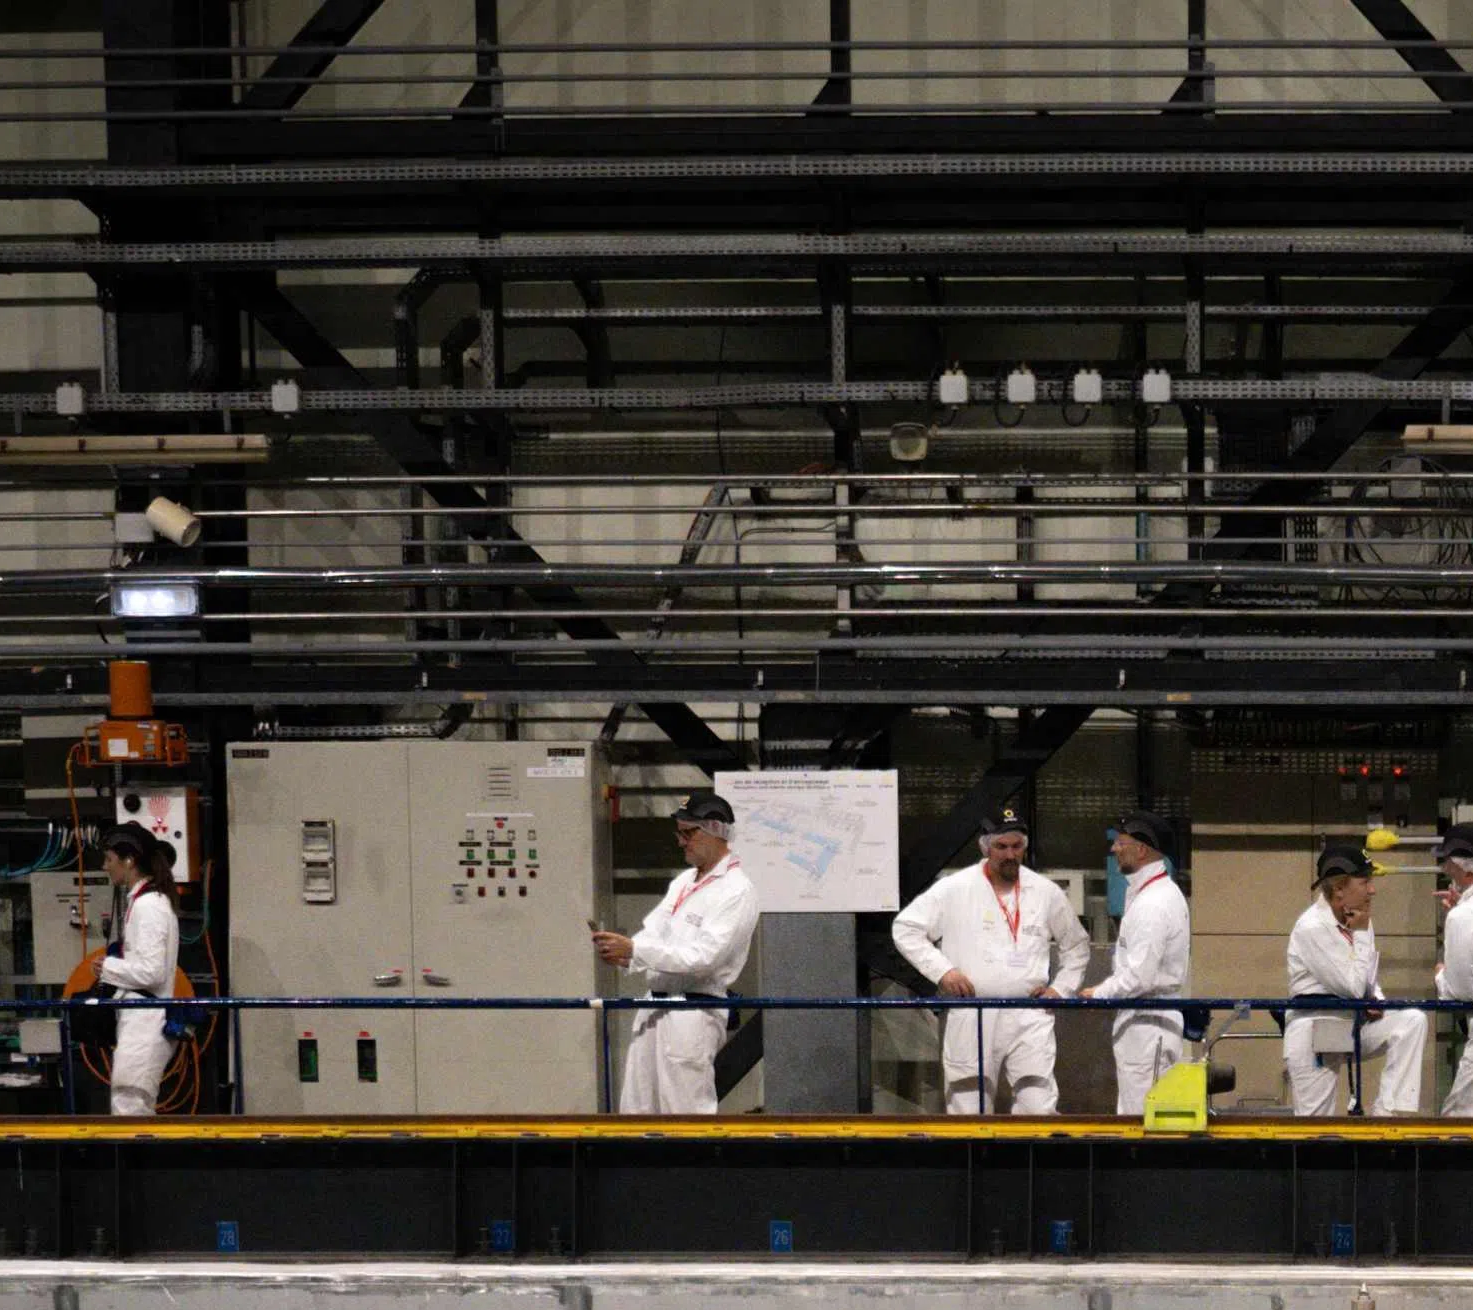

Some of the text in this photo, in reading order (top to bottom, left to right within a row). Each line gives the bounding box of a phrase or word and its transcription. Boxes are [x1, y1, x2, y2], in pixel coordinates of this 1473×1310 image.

[220, 1229, 236, 1247] 28
[774, 1228, 789, 1246] 26
[1336, 1231, 1351, 1249] 24
